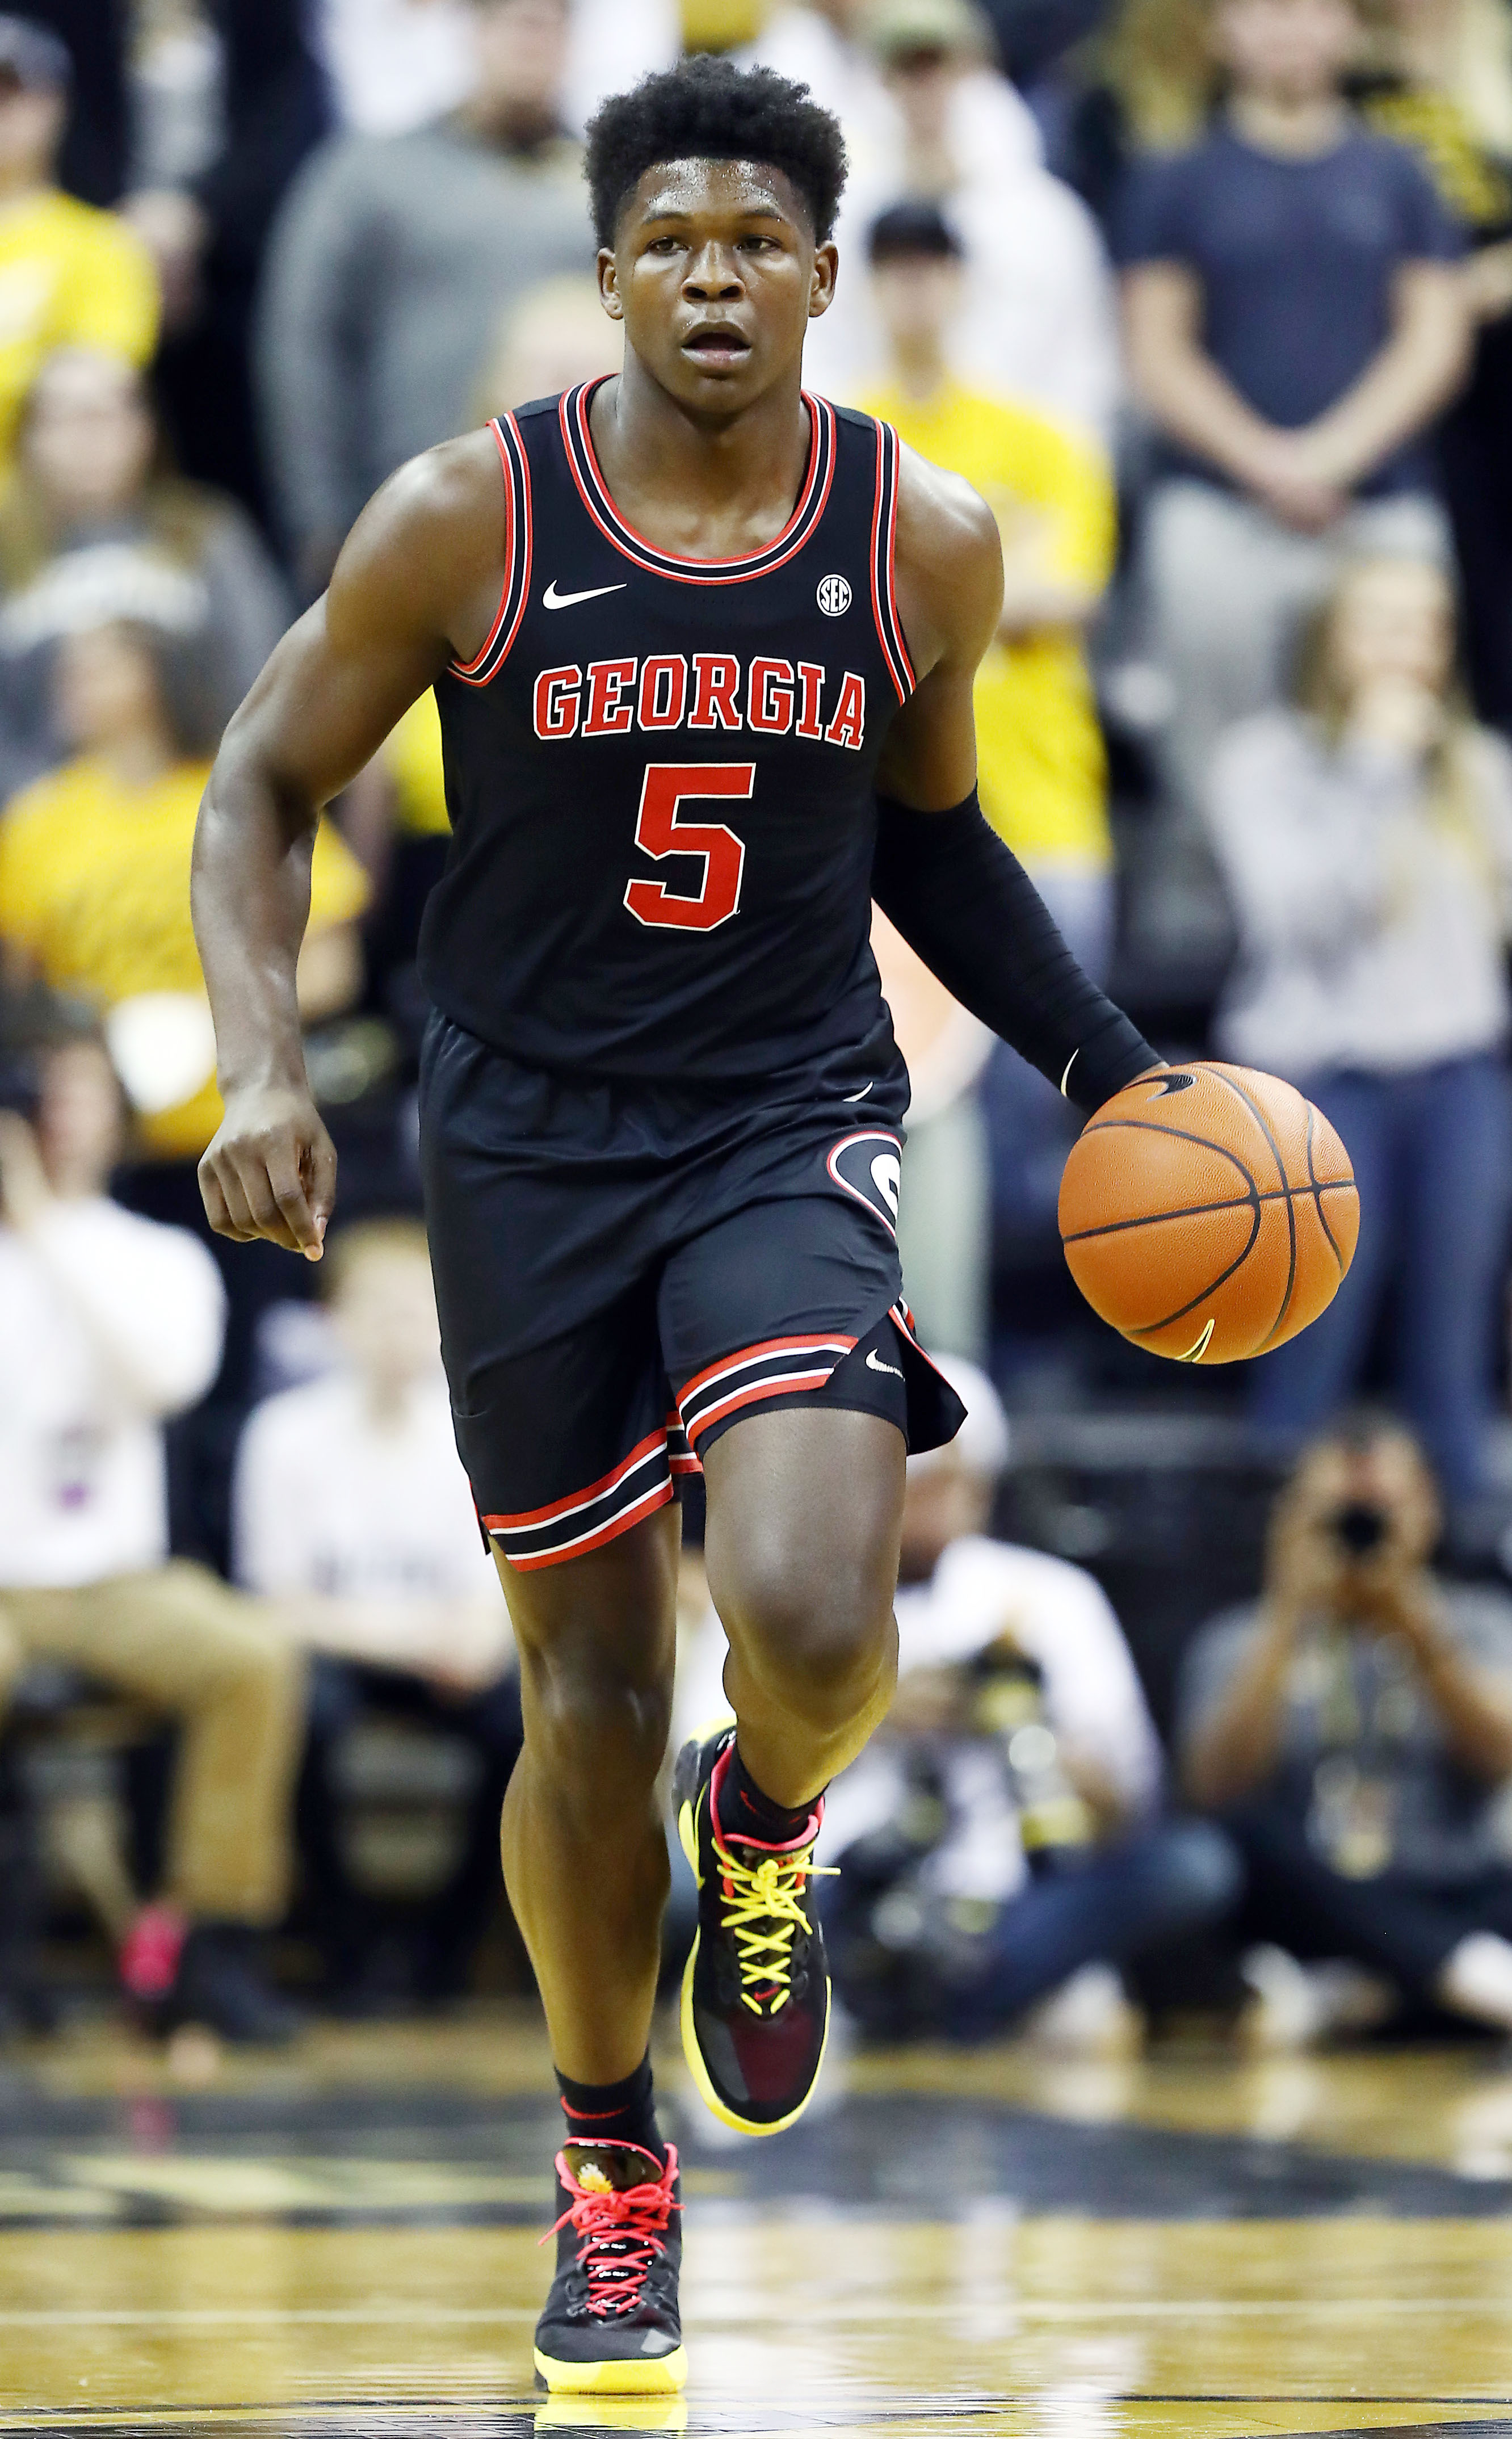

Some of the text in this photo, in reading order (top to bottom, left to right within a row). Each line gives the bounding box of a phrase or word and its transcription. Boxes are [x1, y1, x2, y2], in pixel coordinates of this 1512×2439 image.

[820, 578, 849, 612] SEC
[534, 653, 865, 750] GEORGIA
[623, 762, 756, 931] 5
